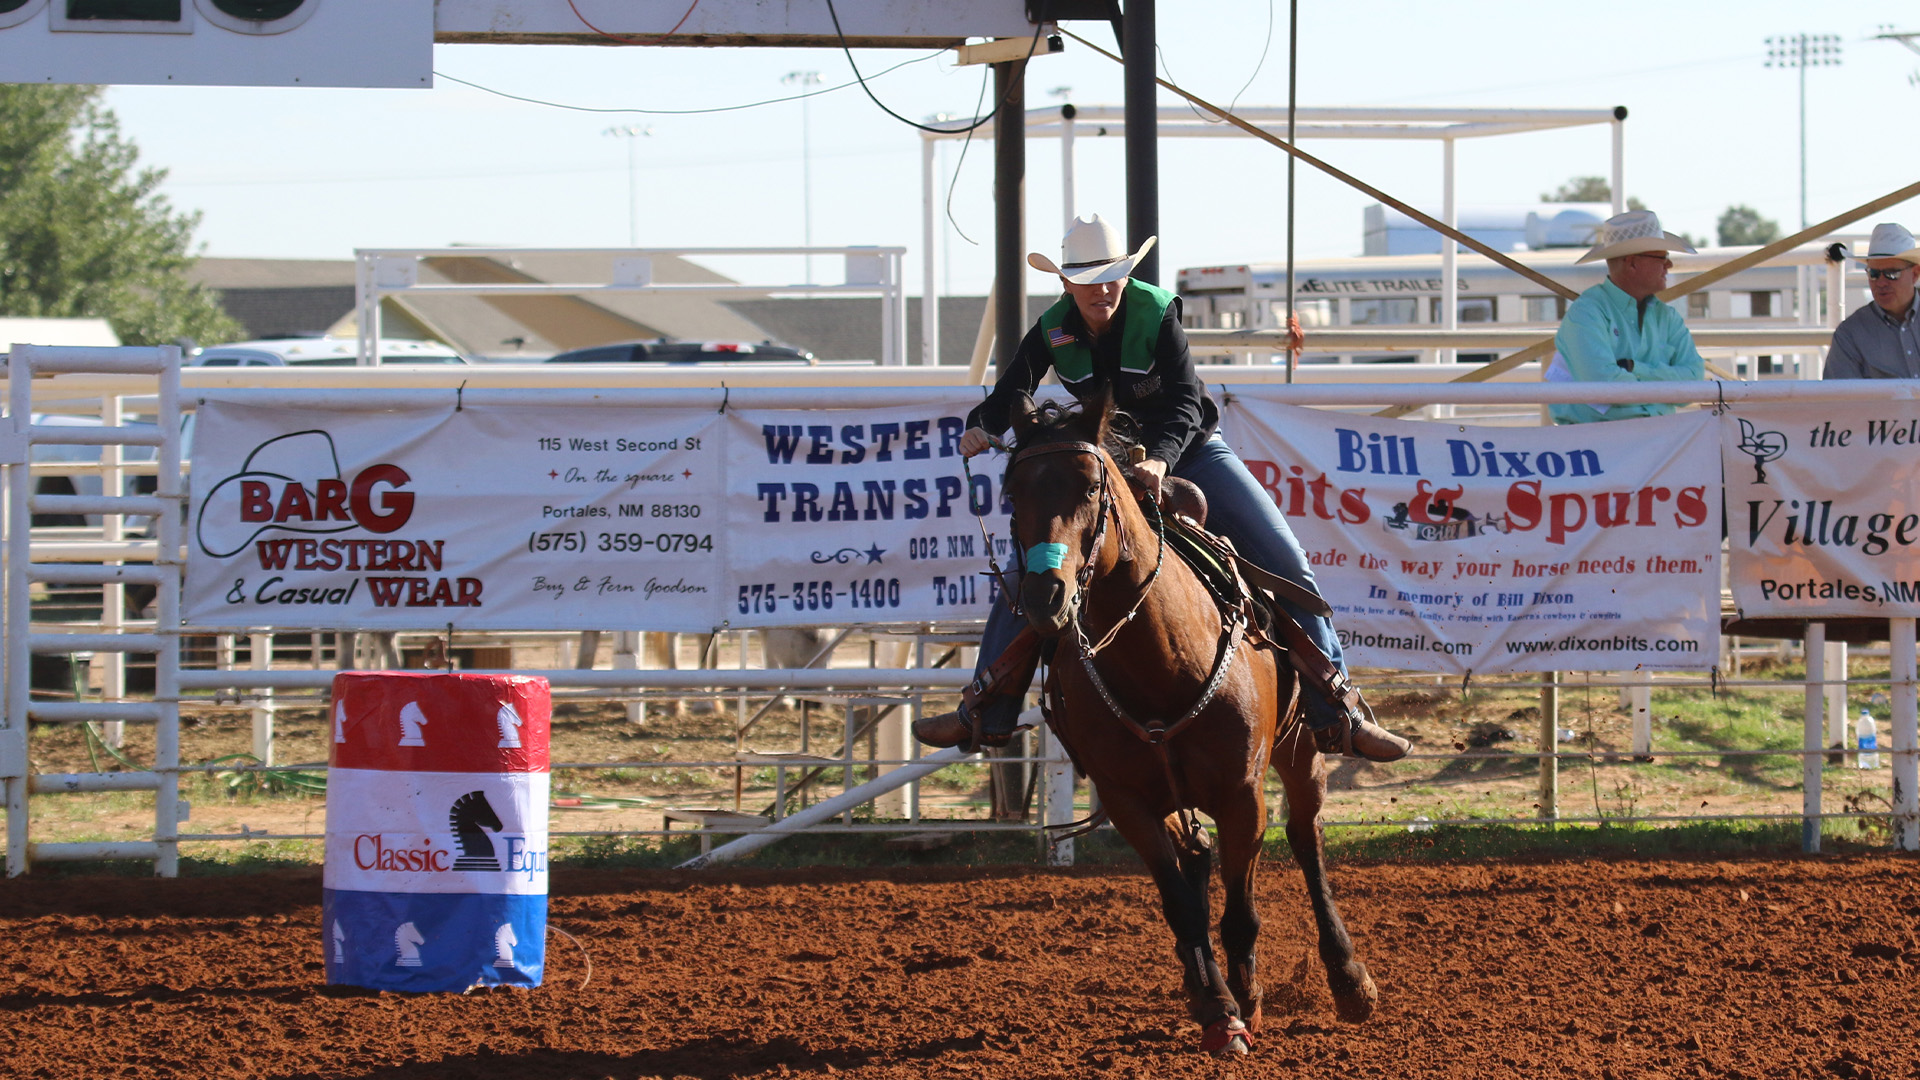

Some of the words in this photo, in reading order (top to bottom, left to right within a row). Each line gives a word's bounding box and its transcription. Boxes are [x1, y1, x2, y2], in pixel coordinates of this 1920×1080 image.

[1368, 277, 1470, 292] TRAILES
[538, 438, 561, 451] 115
[569, 438, 608, 452] West
[616, 438, 677, 452] Second
[685, 437, 702, 451] St
[762, 416, 1005, 464] WESTER
[1810, 421, 1852, 448] the
[1867, 419, 1920, 446] Wel
[1335, 428, 1420, 476] Bill
[1446, 439, 1604, 478] Dixon
[564, 467, 587, 483] On
[593, 468, 618, 483] the
[624, 473, 674, 489] square
[543, 505, 611, 519] Portales,
[618, 504, 643, 517] NM
[651, 504, 701, 518] 88130
[1408, 479, 1464, 525] &
[1504, 480, 1708, 545] Spurs
[528, 531, 587, 553] (575)
[598, 533, 713, 552] 359-0794
[1747, 500, 1919, 556] Village
[256, 539, 445, 572] WESTERN
[947, 535, 974, 558] NM
[1359, 551, 1388, 571] the
[1401, 559, 1443, 580] way
[1452, 560, 1502, 580] your
[1512, 559, 1570, 578] horse
[1576, 556, 1636, 574] needs
[226, 578, 246, 604] &
[255, 577, 359, 605] Casual
[366, 577, 483, 608] WEAR
[644, 577, 708, 600] Goodson
[738, 578, 900, 614] 575-356-1400
[933, 575, 976, 606] Toll
[1368, 585, 1387, 599] In
[1397, 591, 1463, 608] memory
[1472, 593, 1488, 607] of
[1496, 592, 1524, 607] Bill
[1532, 591, 1574, 606] Dixon
[1506, 635, 1698, 655] www.dixonbits.com
[353, 833, 450, 873] Classic
